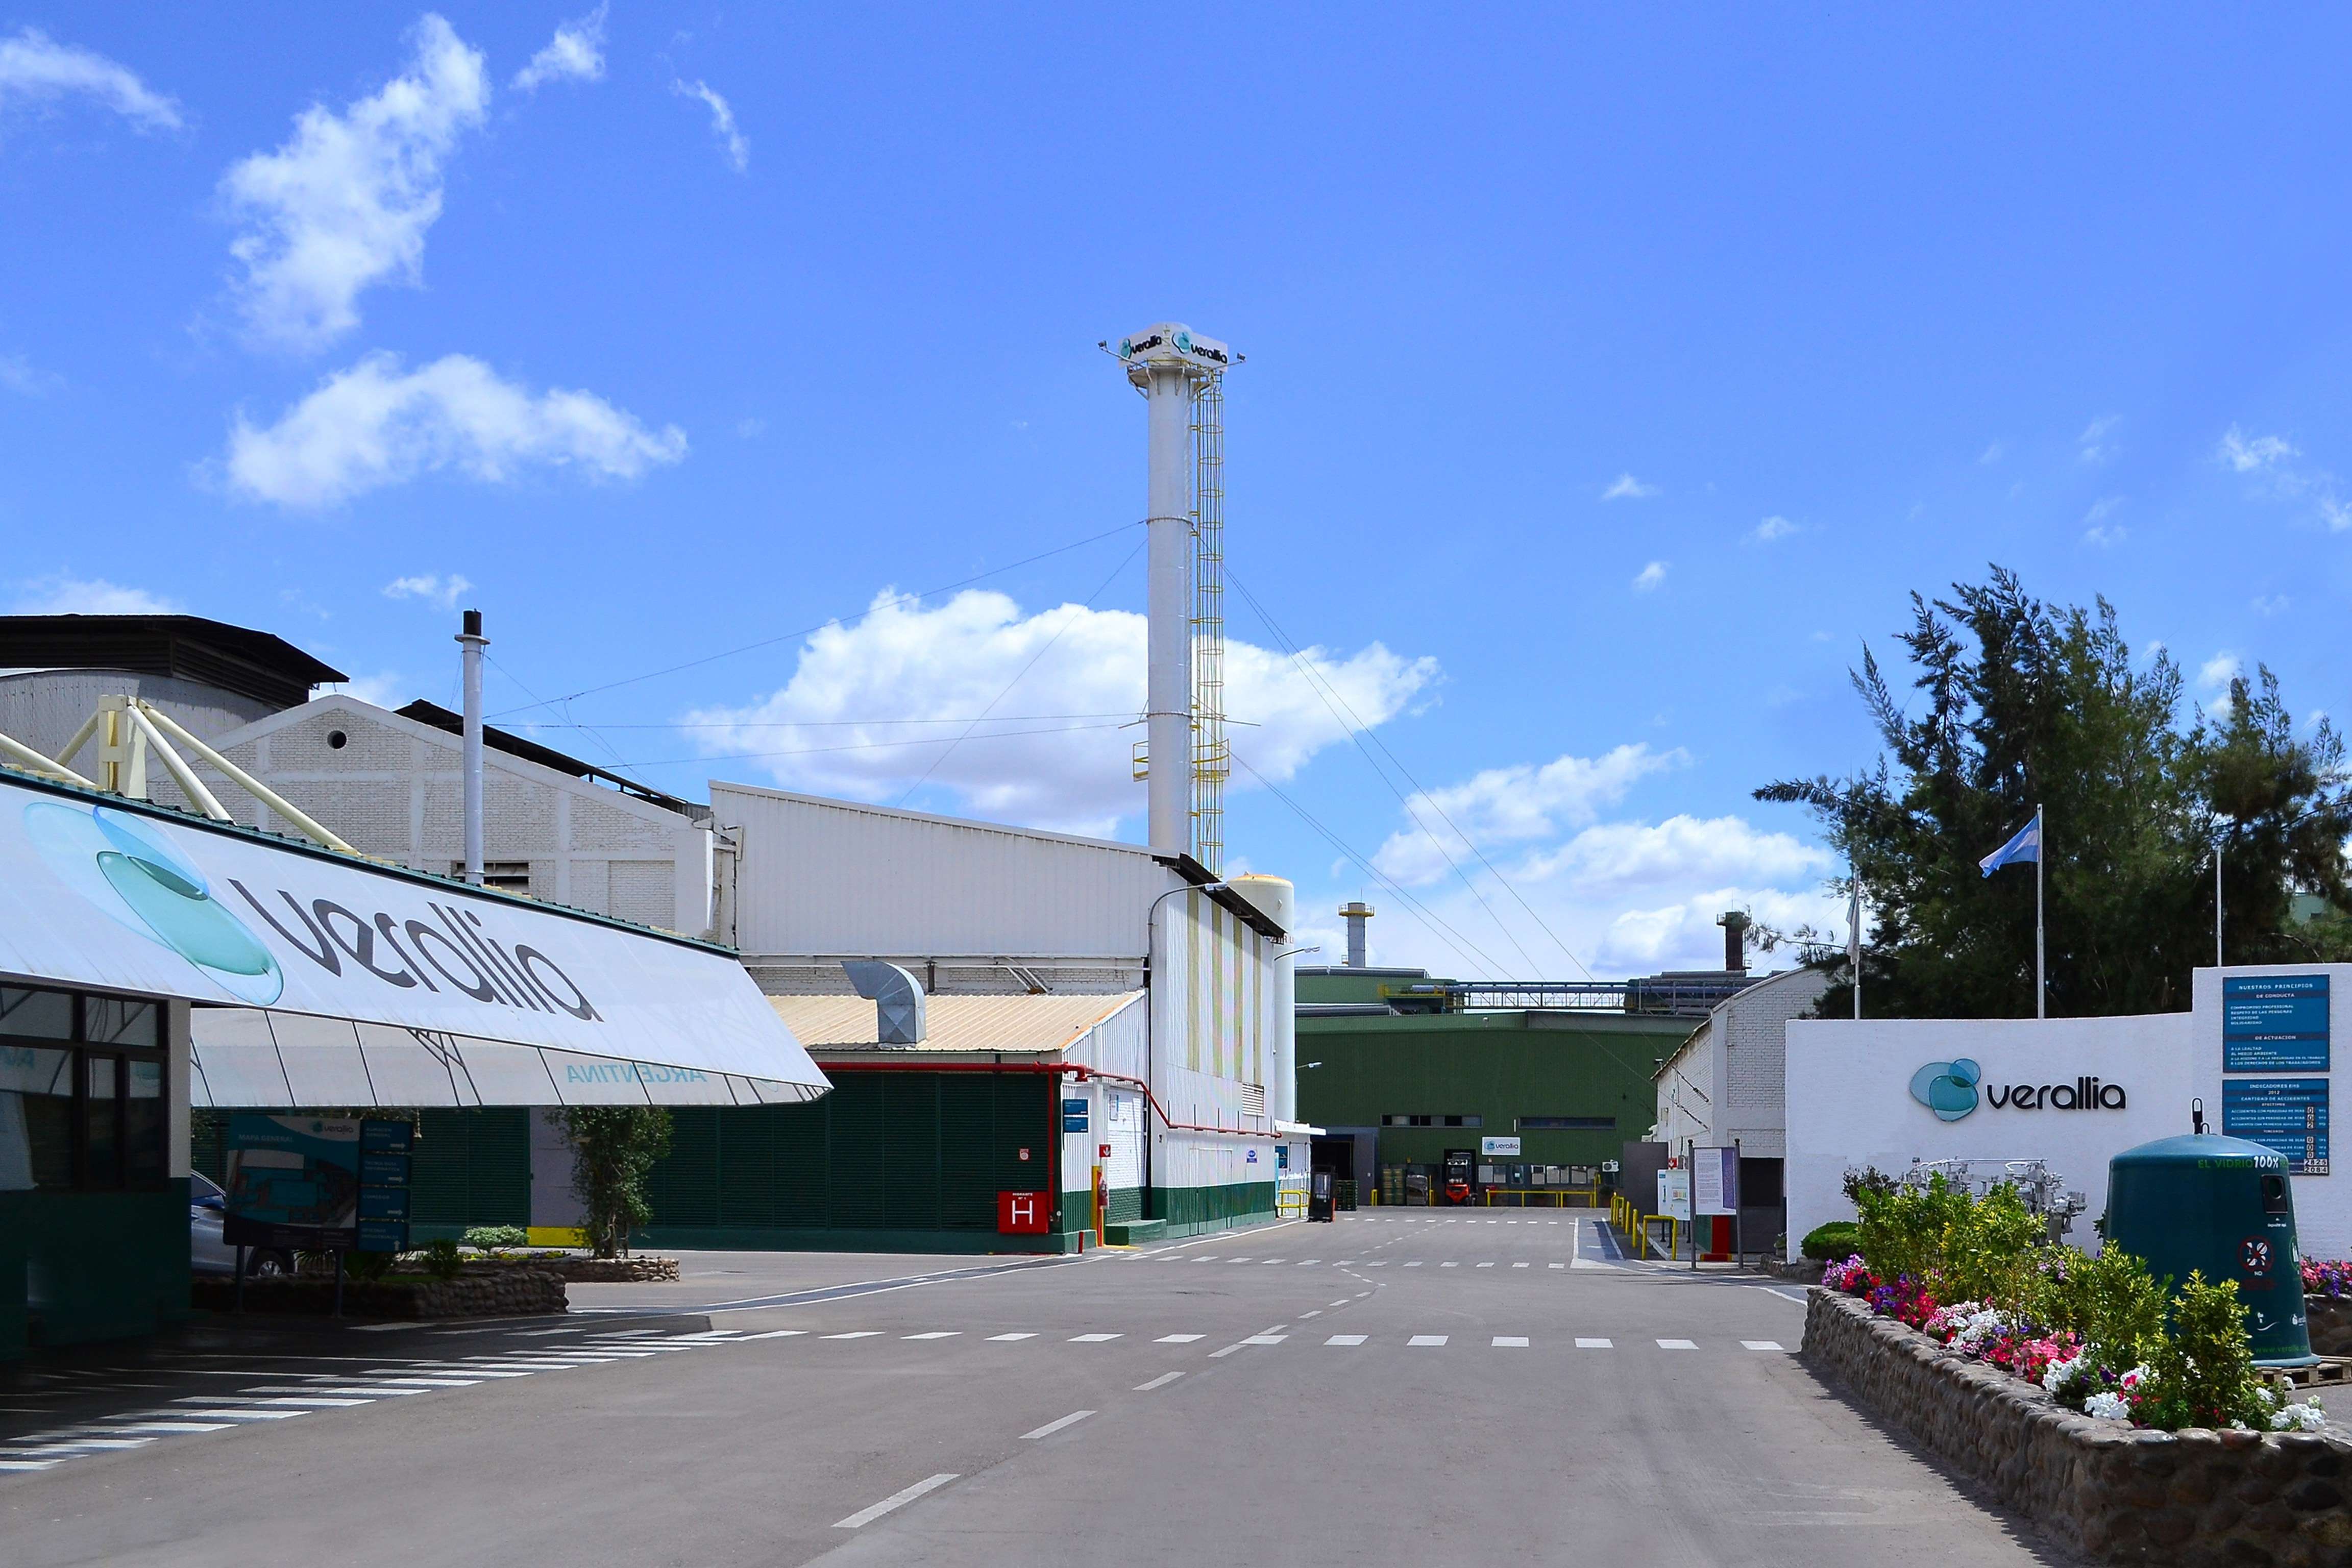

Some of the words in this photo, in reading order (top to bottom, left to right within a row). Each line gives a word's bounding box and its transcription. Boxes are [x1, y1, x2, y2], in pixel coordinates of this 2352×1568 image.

[1191, 344, 1228, 363] verallia
[228, 878, 604, 1022] verallia
[1987, 1076, 2126, 1109] verallia
[260, 1135, 294, 1143] GENERAL
[2198, 1159, 2211, 1168] EL
[2215, 1159, 2253, 1168] VIDRIO
[2254, 1156, 2278, 1169] 100%
[1012, 1199, 1033, 1224] H
